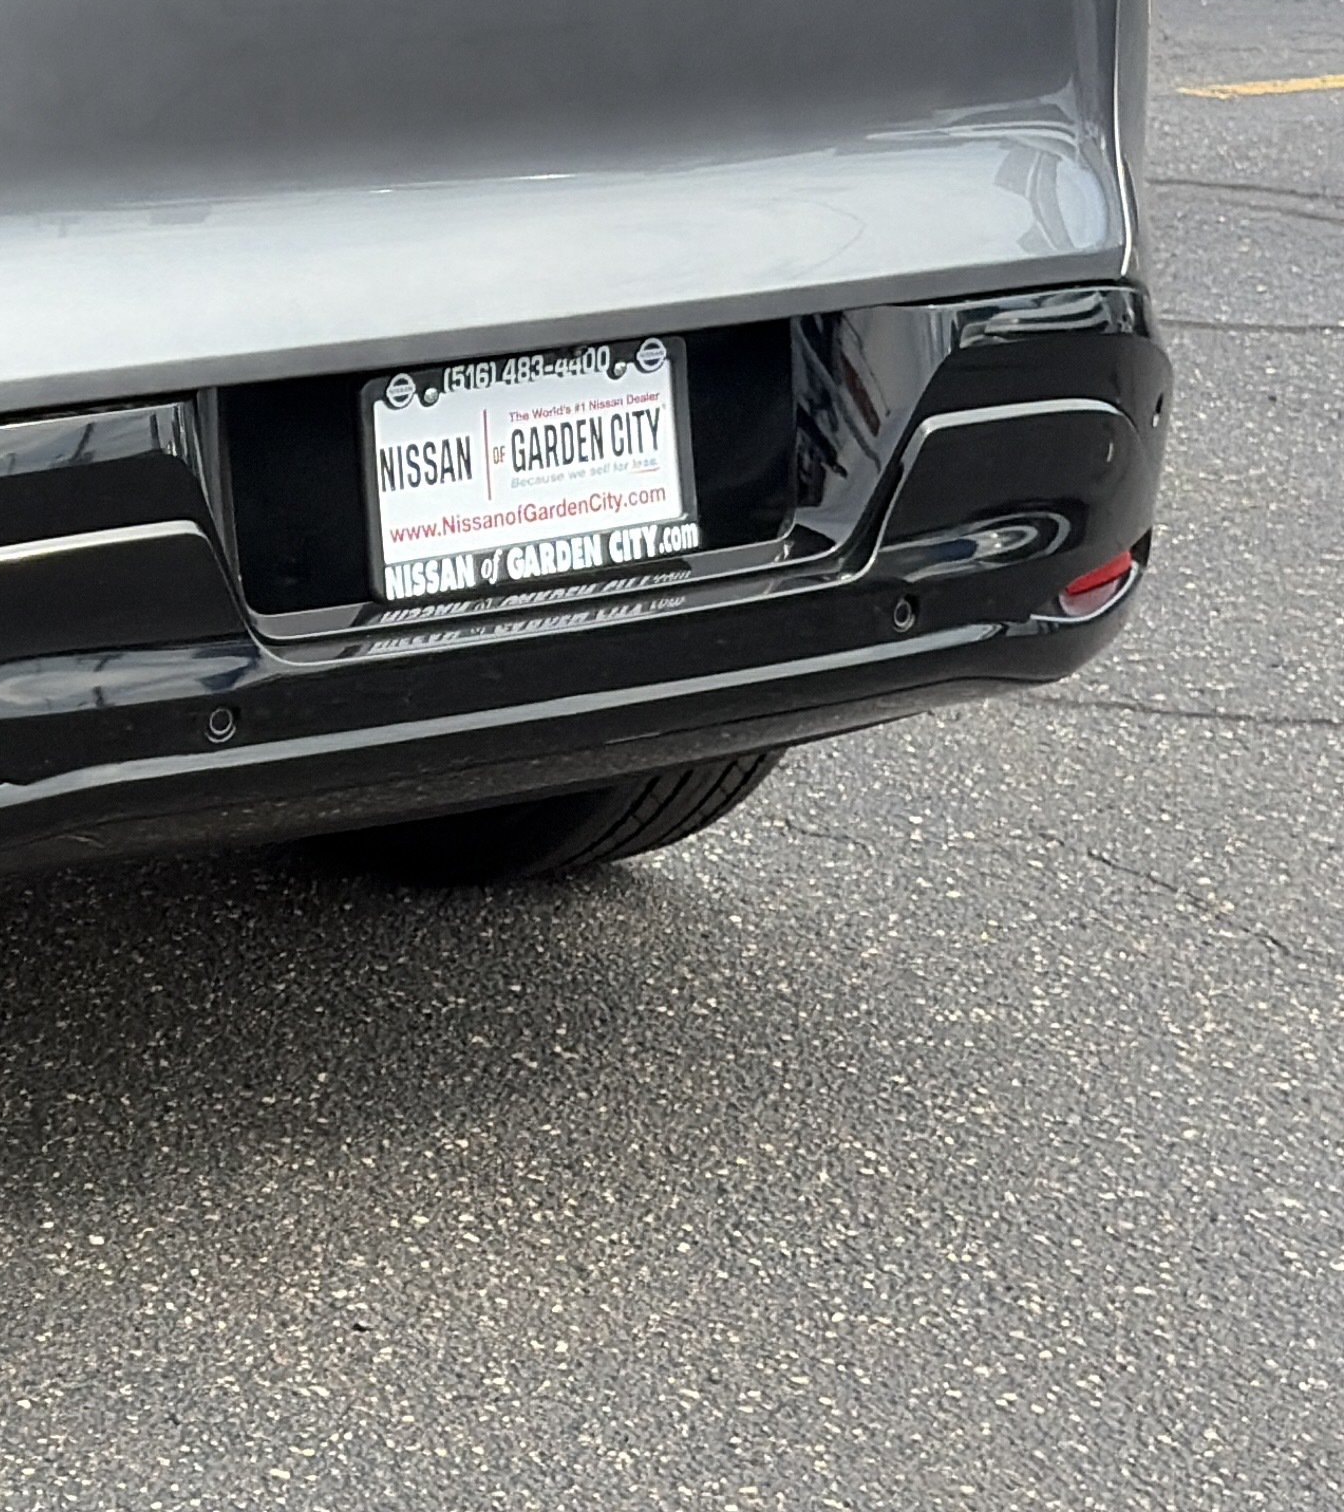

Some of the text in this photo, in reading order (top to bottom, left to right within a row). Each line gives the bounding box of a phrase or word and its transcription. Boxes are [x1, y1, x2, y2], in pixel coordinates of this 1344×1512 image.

[443, 345, 611, 393] (516) 483-4400
[509, 392, 661, 422] The World's #1 Nissan Dealer
[379, 407, 661, 493] NISSAN OF GARDEN CITY
[389, 486, 667, 544] www.NissanofGardenCity.com
[384, 553, 477, 601] NISSAN
[480, 548, 503, 585] of
[506, 533, 604, 581] GARDEN
[608, 520, 700, 565] CITY.com
